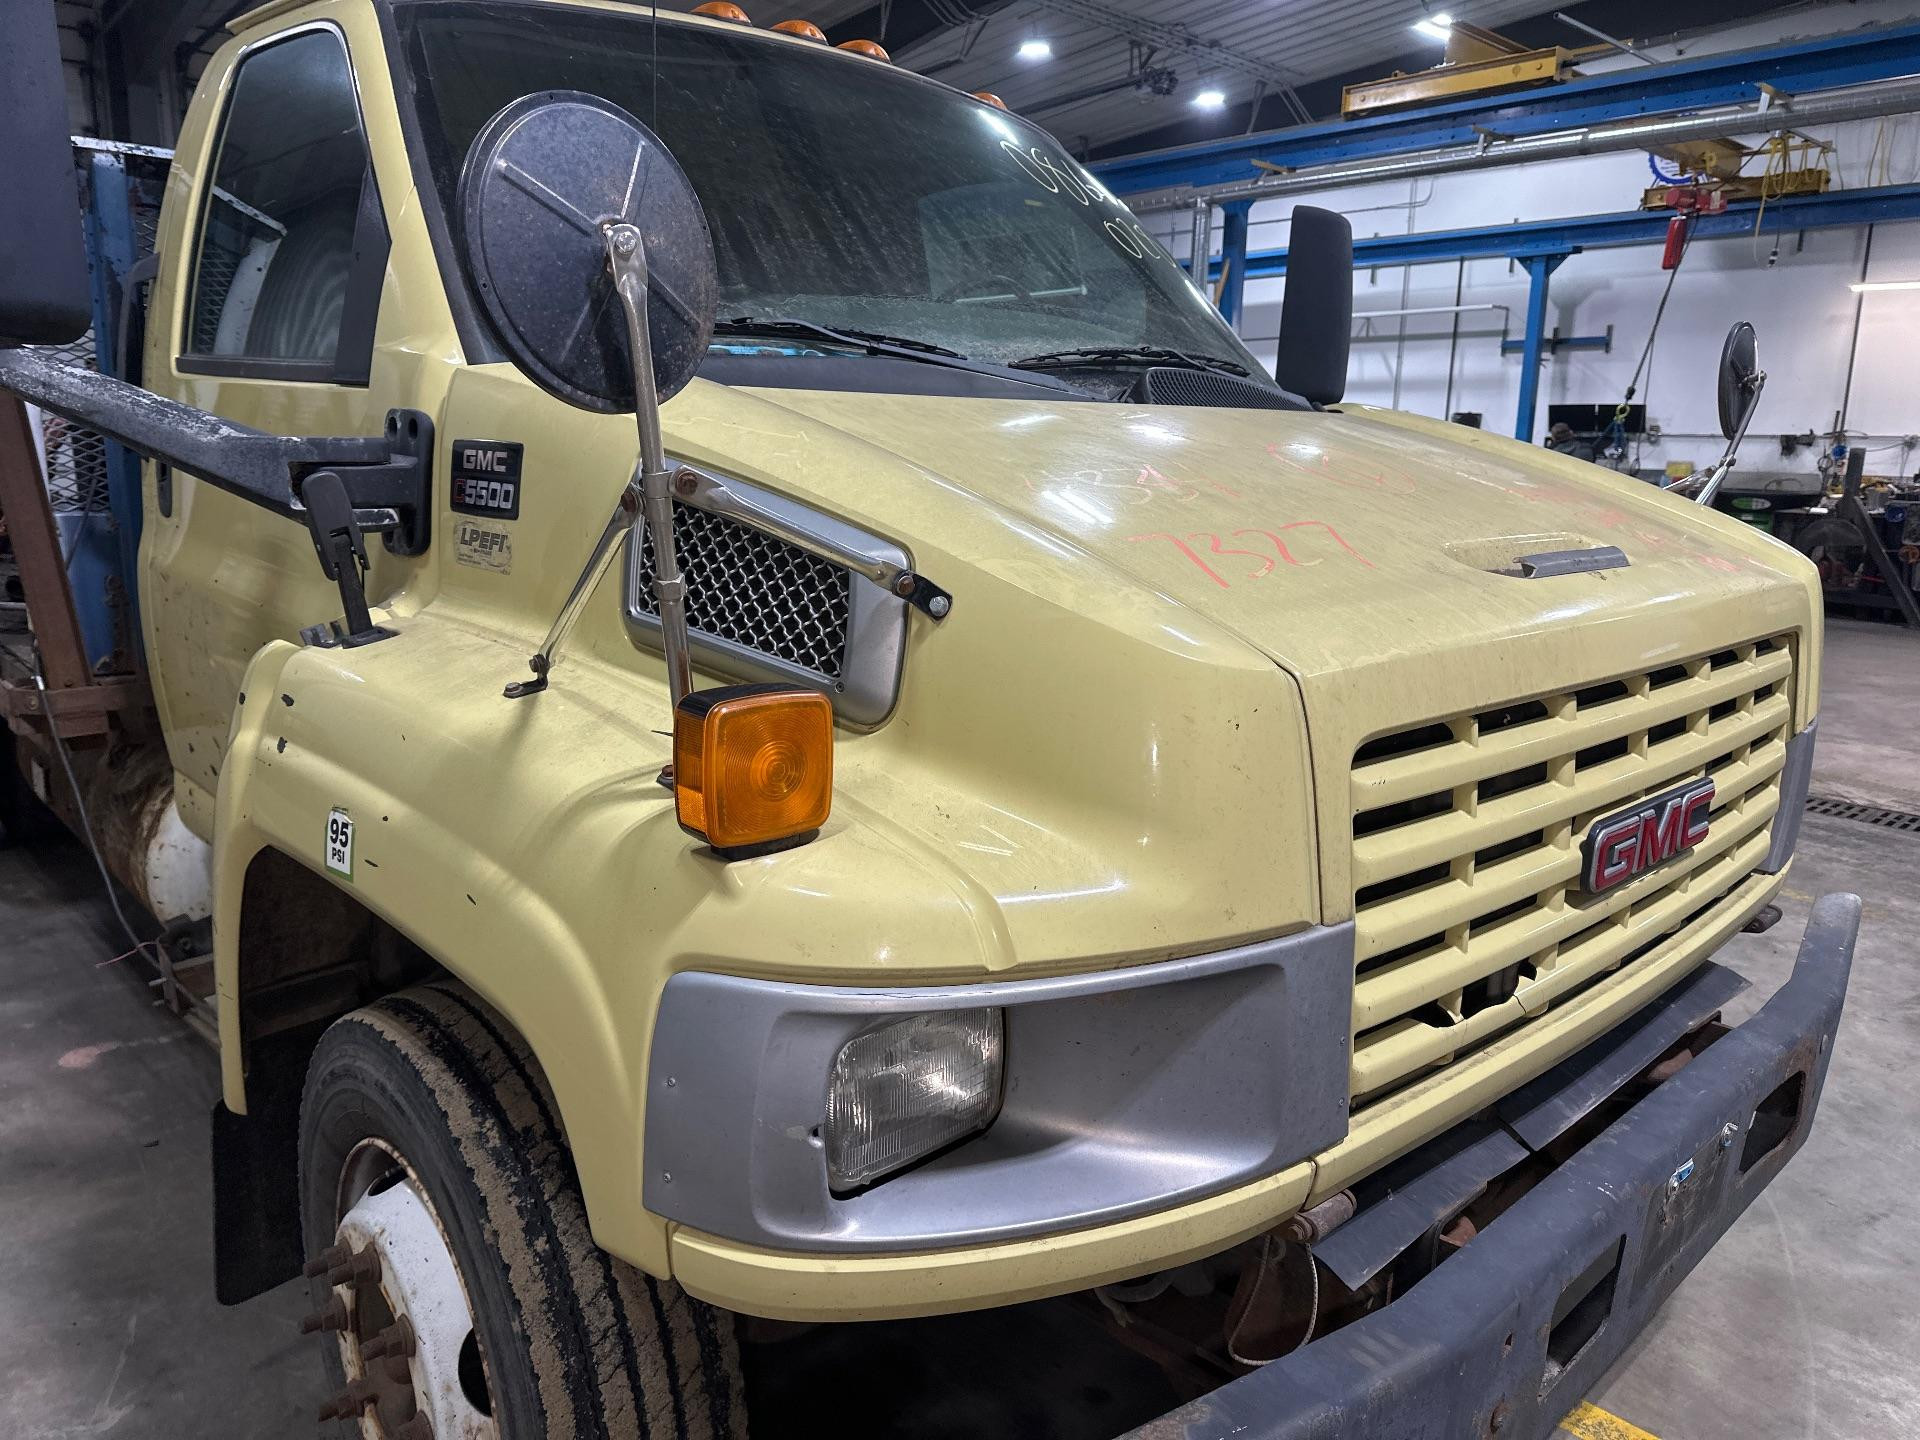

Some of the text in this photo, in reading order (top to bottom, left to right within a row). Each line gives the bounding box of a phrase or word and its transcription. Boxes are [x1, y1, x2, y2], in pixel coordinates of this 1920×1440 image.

[463, 449, 508, 473] GMC
[454, 479, 515, 510] C5500
[1121, 520, 1377, 590] 7327
[330, 818, 349, 848] 95
[1589, 782, 1716, 894] GMC
[331, 847, 345, 865] PSI
